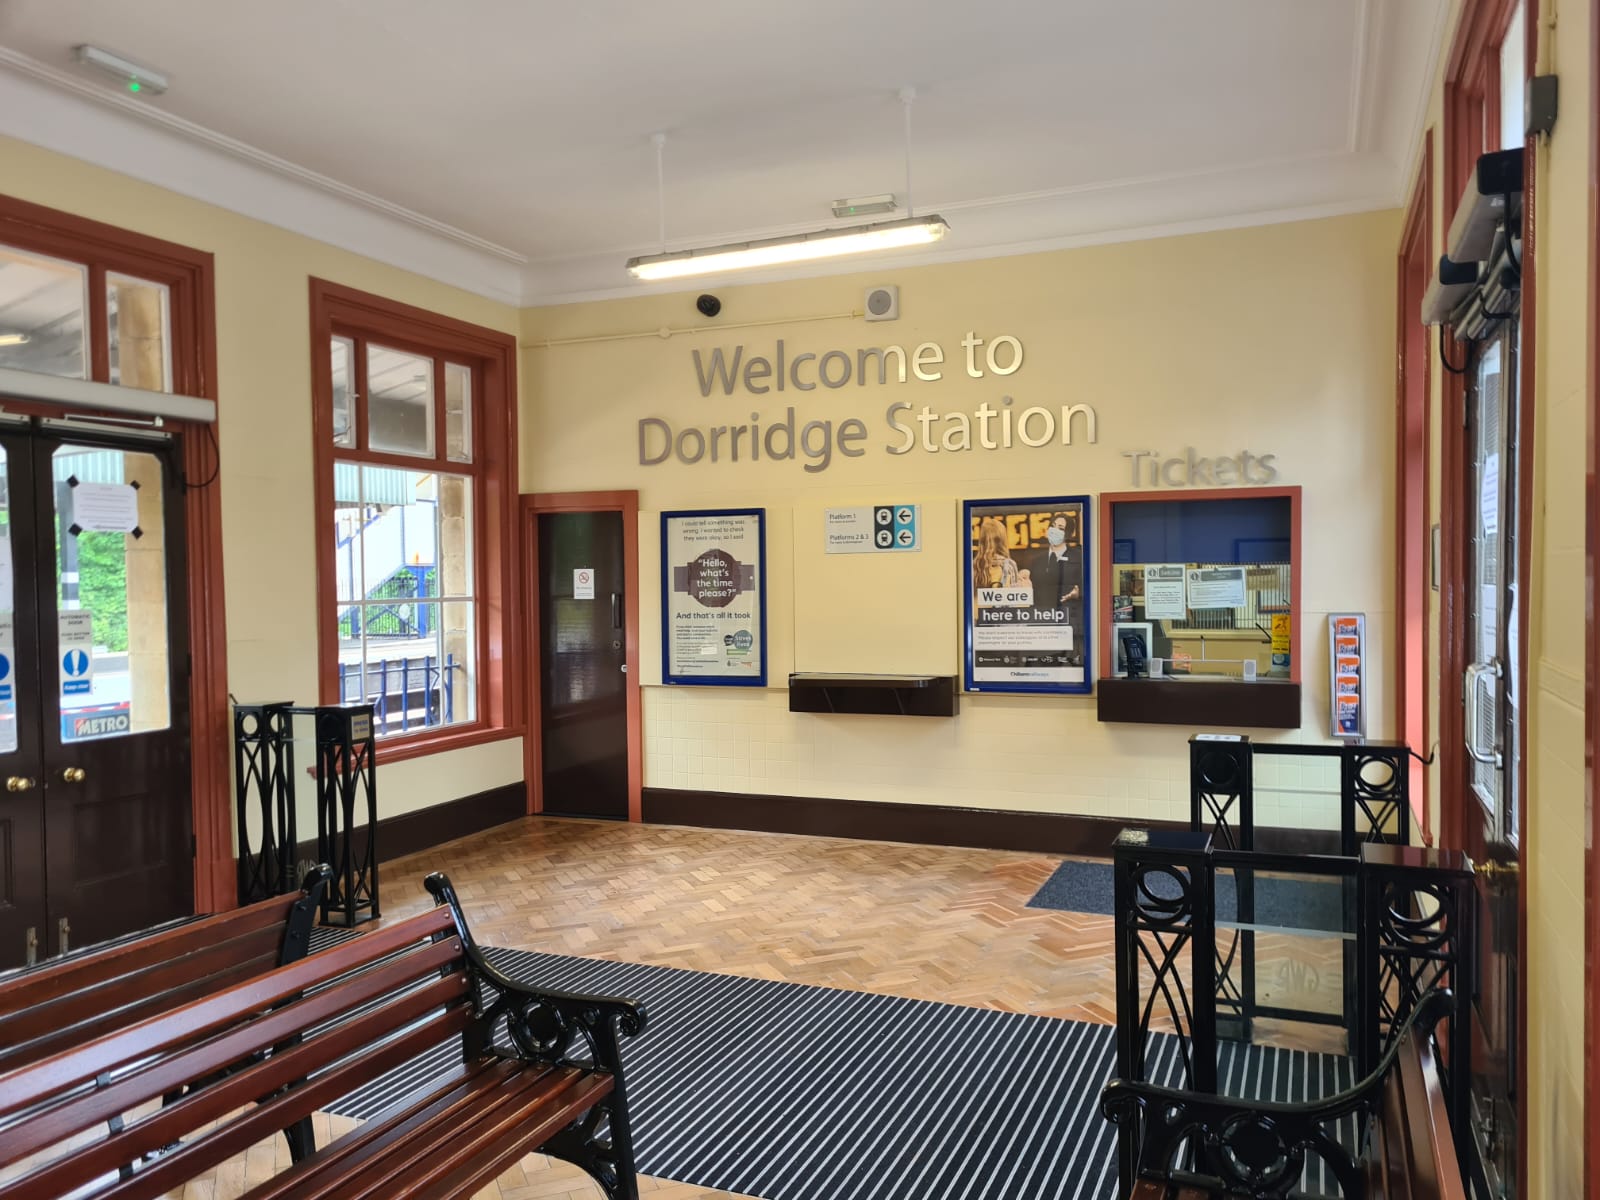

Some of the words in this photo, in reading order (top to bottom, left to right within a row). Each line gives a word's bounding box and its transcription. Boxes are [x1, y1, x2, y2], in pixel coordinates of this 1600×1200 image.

[693, 339, 945, 397] Welcome
[961, 331, 1025, 379] to
[638, 407, 868, 474] Dorridge
[885, 395, 1098, 456] Station
[1121, 446, 1278, 488] Tickets
[700, 569, 729, 577] what's
[697, 579, 711, 587] the
[713, 579, 733, 587] time
[982, 591, 1003, 602] We
[1006, 592, 1029, 602] are
[693, 611, 715, 619] that's
[716, 611, 726, 619] all
[982, 609, 1013, 621] here
[1016, 609, 1030, 621] to
[1034, 608, 1065, 622] help
[78, 715, 128, 736] METRO
